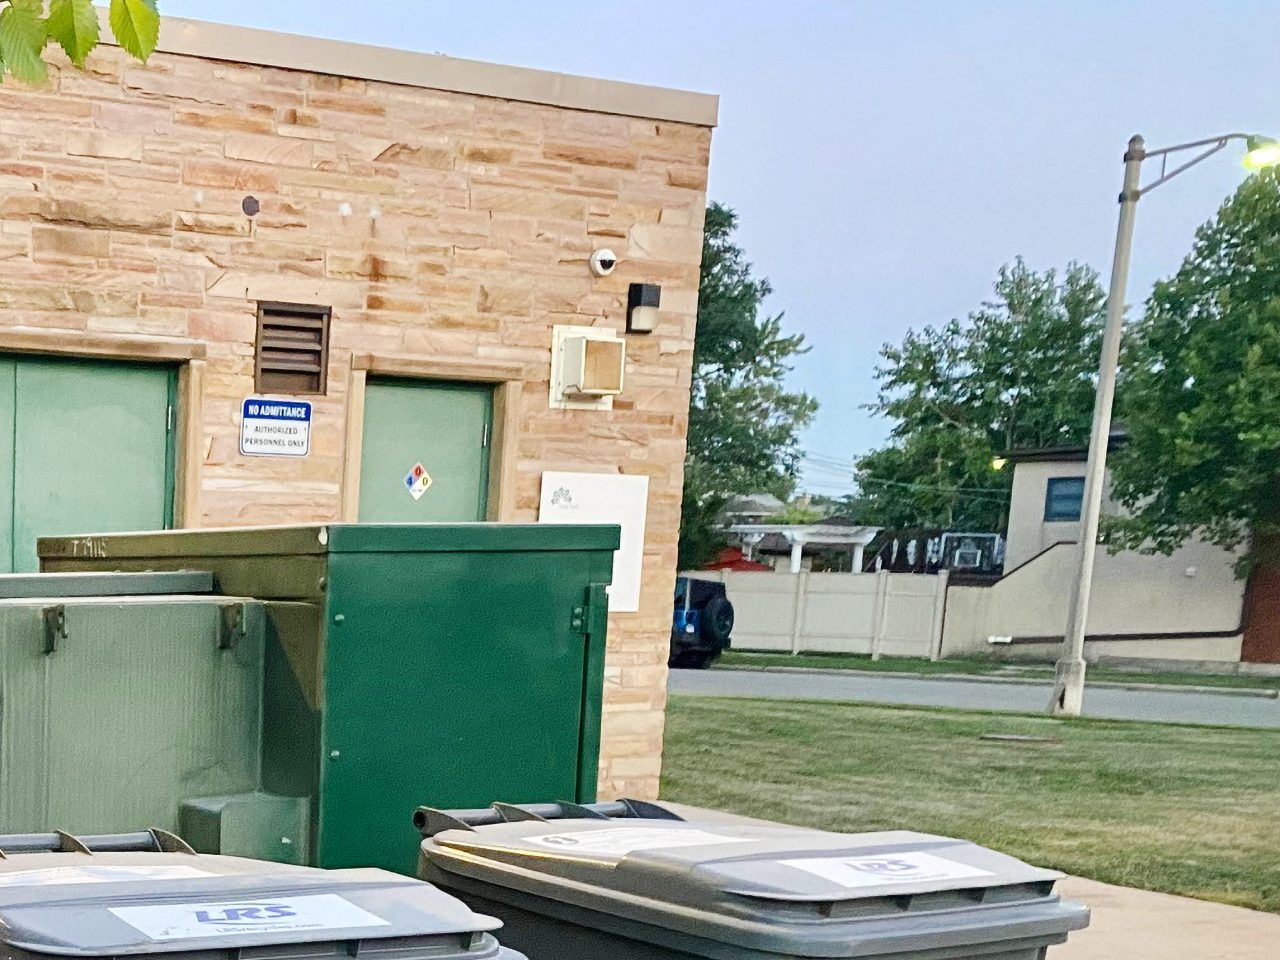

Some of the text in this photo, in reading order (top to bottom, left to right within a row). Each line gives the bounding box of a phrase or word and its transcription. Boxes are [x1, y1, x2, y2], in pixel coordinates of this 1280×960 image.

[248, 405, 307, 418] NO ADMITTANCE
[255, 425, 298, 435] AUTHORIZED
[244, 437, 305, 448] PERSONNEL ONLY
[195, 905, 297, 924] LRS
